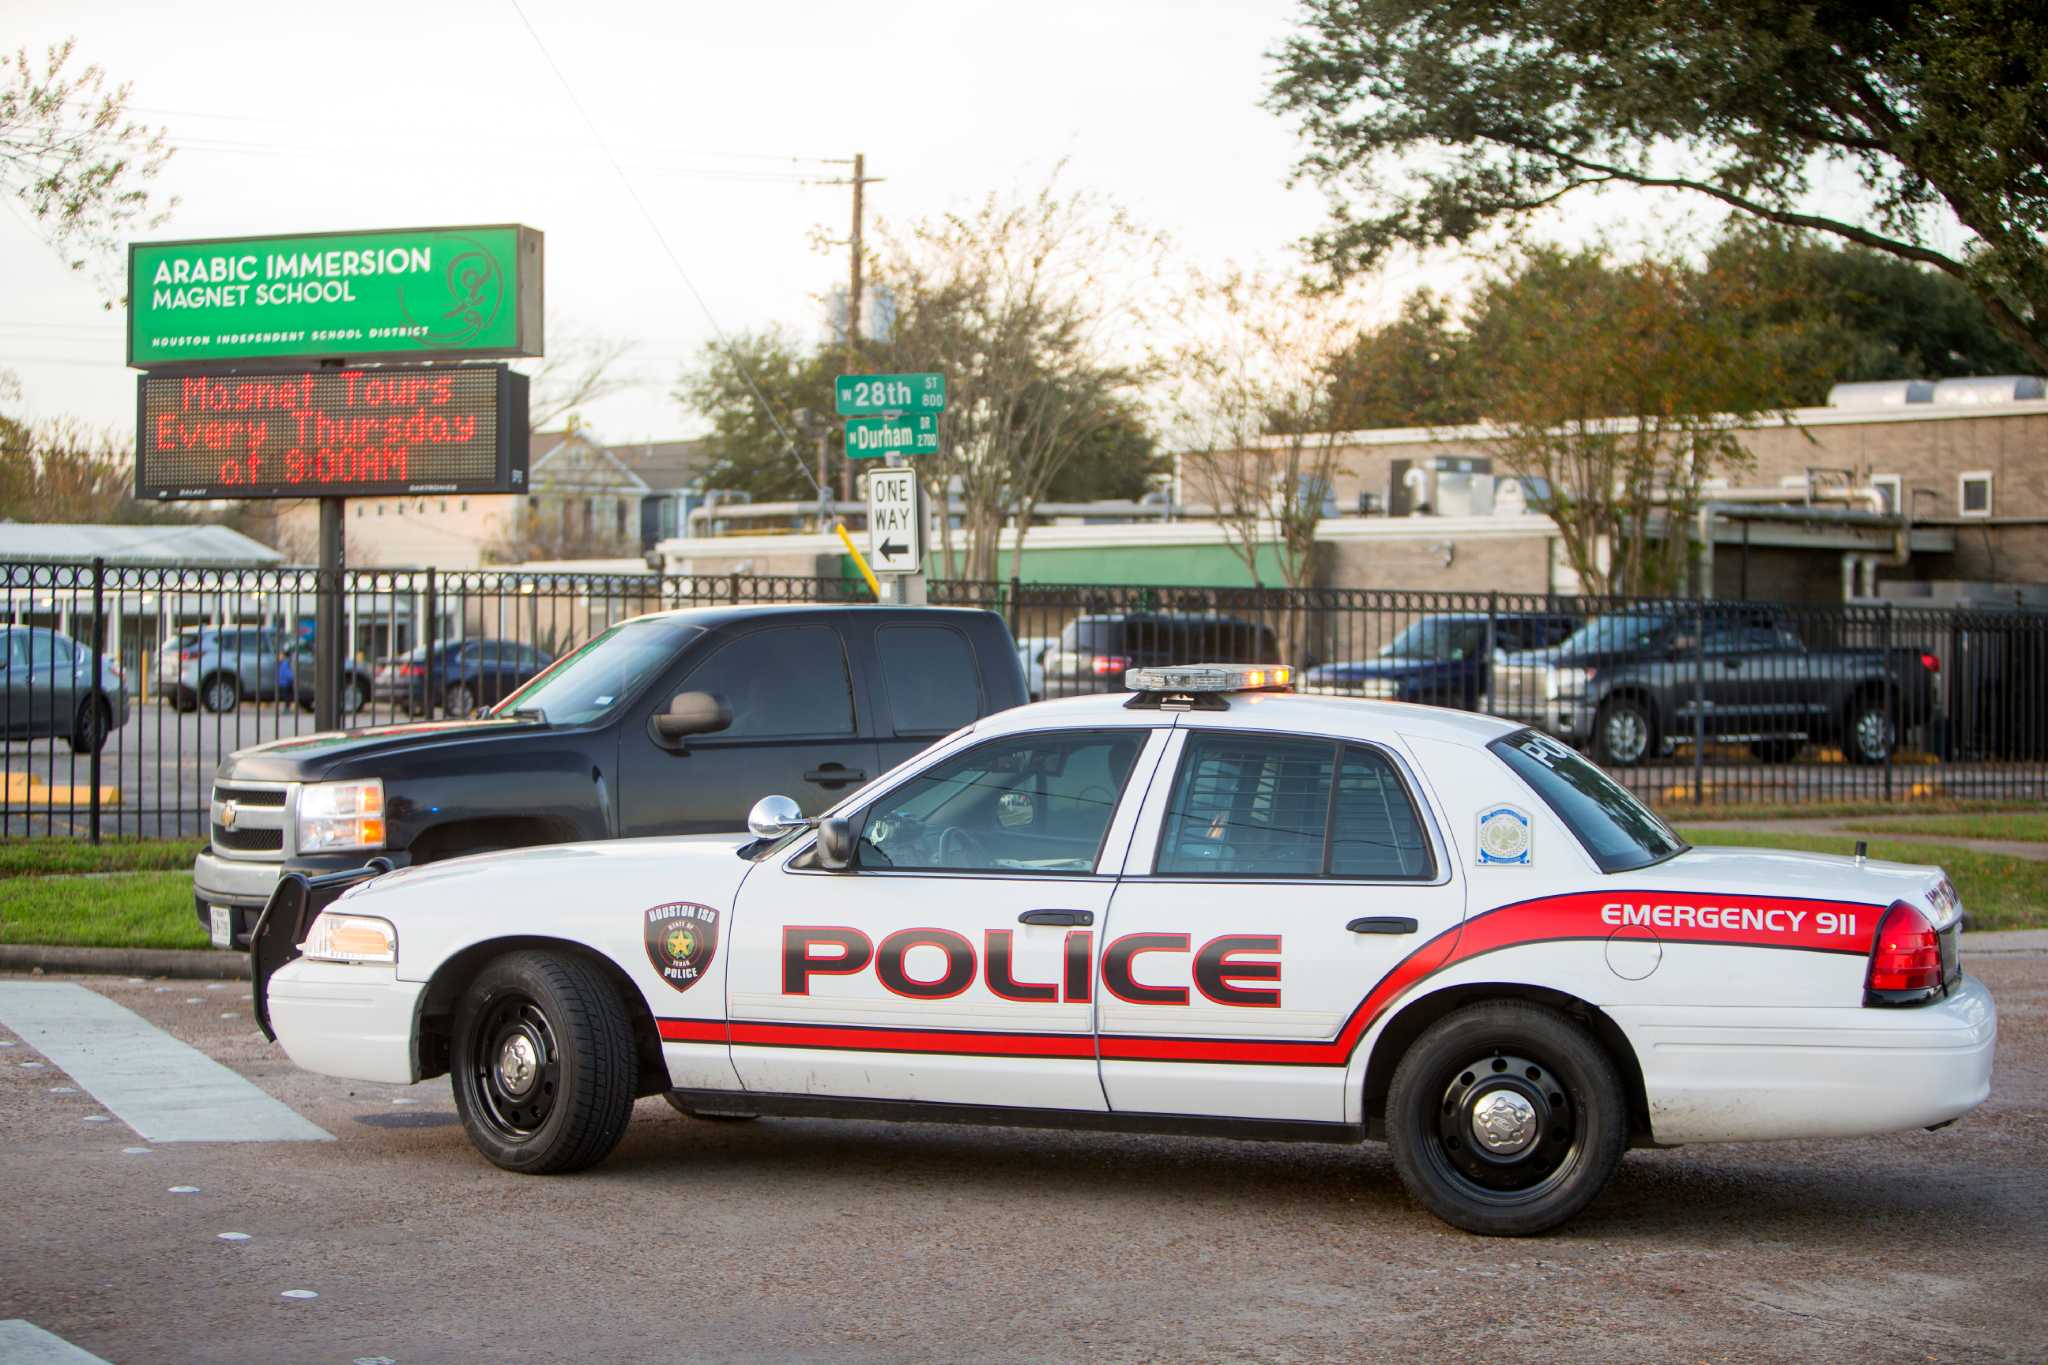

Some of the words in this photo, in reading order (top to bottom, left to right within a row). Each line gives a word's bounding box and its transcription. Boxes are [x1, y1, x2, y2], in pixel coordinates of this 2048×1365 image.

[152, 255, 258, 285] ARABIC
[266, 247, 432, 280] IMMERSION
[151, 284, 251, 311] MAGNET
[255, 280, 356, 306] SCHOOL
[151, 336, 211, 348] HOUSTON
[216, 331, 305, 345] INDEPENDENT
[311, 329, 363, 341] SCHOOL
[369, 325, 430, 338] DISTRICT
[182, 372, 314, 413] Magnet
[340, 370, 455, 407] Tours
[842, 389, 852, 401] W
[855, 382, 912, 407] 28th
[925, 376, 937, 389] ST
[156, 412, 268, 451] Every
[291, 407, 477, 446] Thursday
[857, 424, 912, 449] Durham
[219, 450, 264, 487] at
[876, 479, 909, 502] ONE
[875, 508, 910, 531] WAY
[649, 904, 696, 922] HOUSTON
[697, 907, 717, 923] ISD
[1601, 903, 1807, 934] EMERGENCY
[1816, 913, 1856, 935] 911
[664, 966, 698, 979] POLICE
[781, 925, 1283, 1009] POLICE
